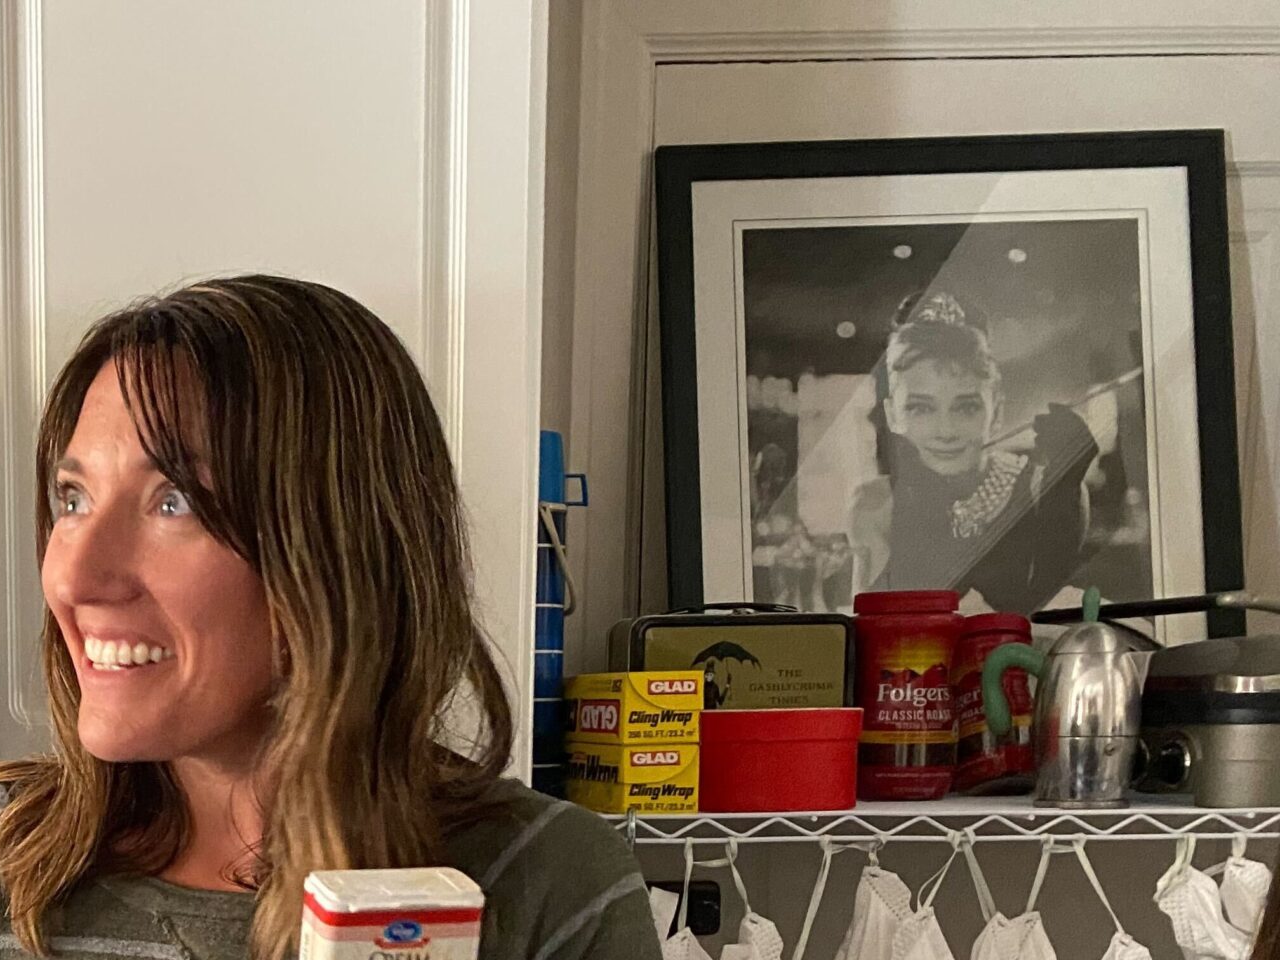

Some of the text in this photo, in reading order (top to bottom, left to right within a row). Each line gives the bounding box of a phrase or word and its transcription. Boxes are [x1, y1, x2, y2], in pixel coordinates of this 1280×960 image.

[777, 668, 804, 679] THE
[649, 680, 697, 694] GLAD
[876, 683, 952, 707] Folgers
[581, 704, 618, 732] GLAD
[628, 709, 694, 728] Cling Wrap
[877, 708, 925, 723] CLASSIC
[632, 751, 679, 766] GLAD
[628, 783, 695, 801] Cling Wrap
